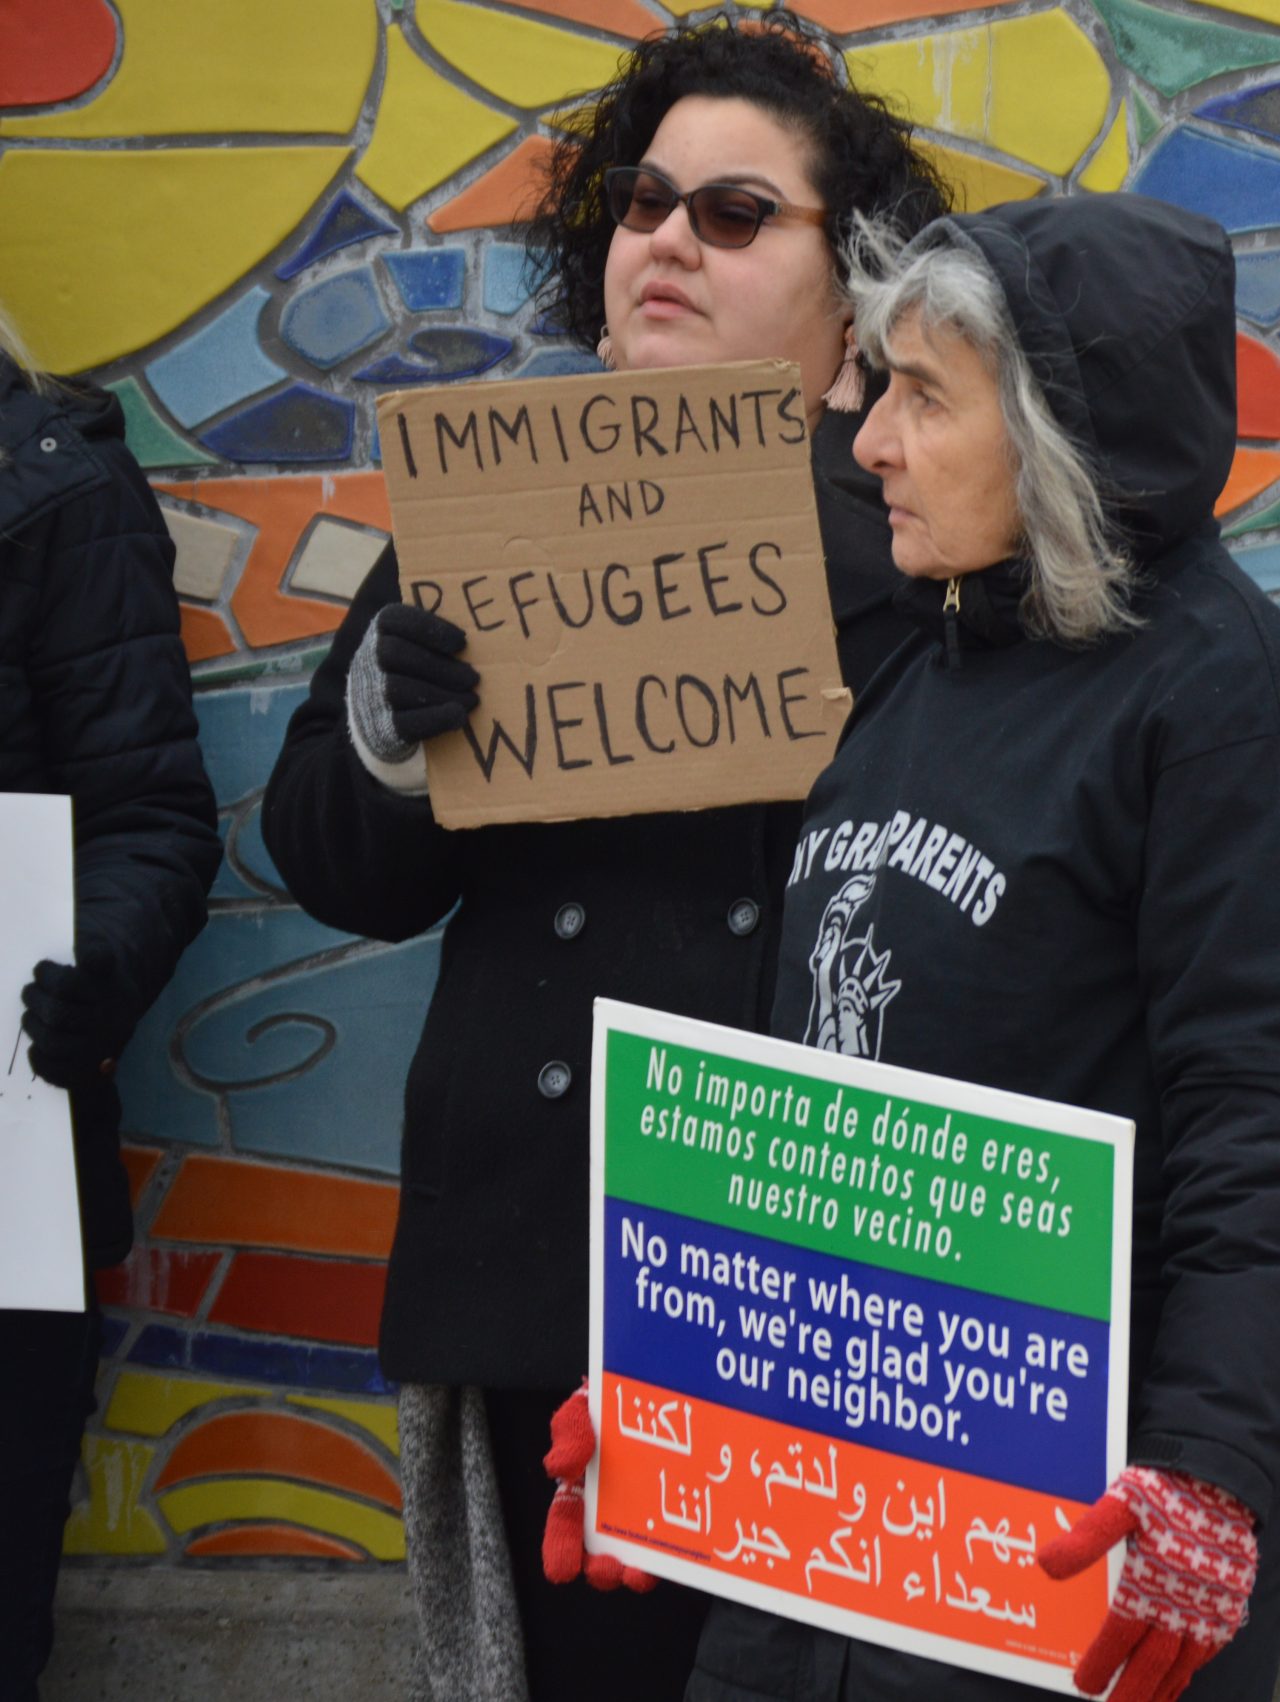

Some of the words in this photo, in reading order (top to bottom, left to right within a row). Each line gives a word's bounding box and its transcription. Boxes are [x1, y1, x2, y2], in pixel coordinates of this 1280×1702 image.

[397, 388, 807, 478] IMMIGRANTS
[579, 479, 665, 527] AND
[462, 667, 826, 782] WELCOME
[640, 1104, 756, 1161] estamos
[768, 1136, 915, 1200] contentos
[929, 1175, 986, 1219] que
[1000, 1191, 1073, 1237] seas
[646, 1047, 682, 1096] No
[695, 1060, 811, 1128] importa
[824, 1088, 858, 1138] de
[871, 1100, 968, 1164] dónde
[982, 1139, 1060, 1195] eres,
[728, 1174, 838, 1230] nuestro
[854, 1205, 962, 1262] vecino.
[621, 1217, 667, 1267] No
[681, 1243, 797, 1303] matter
[808, 1273, 925, 1337] where
[939, 1310, 1010, 1359] you
[1024, 1332, 1090, 1378] are
[636, 1266, 726, 1337] from,
[738, 1305, 832, 1361] we're
[846, 1329, 929, 1387] glad
[944, 1360, 1069, 1422] you're
[716, 1347, 775, 1392] our
[788, 1366, 969, 1446] neighbor.
[965, 1516, 1036, 1568] يهم
